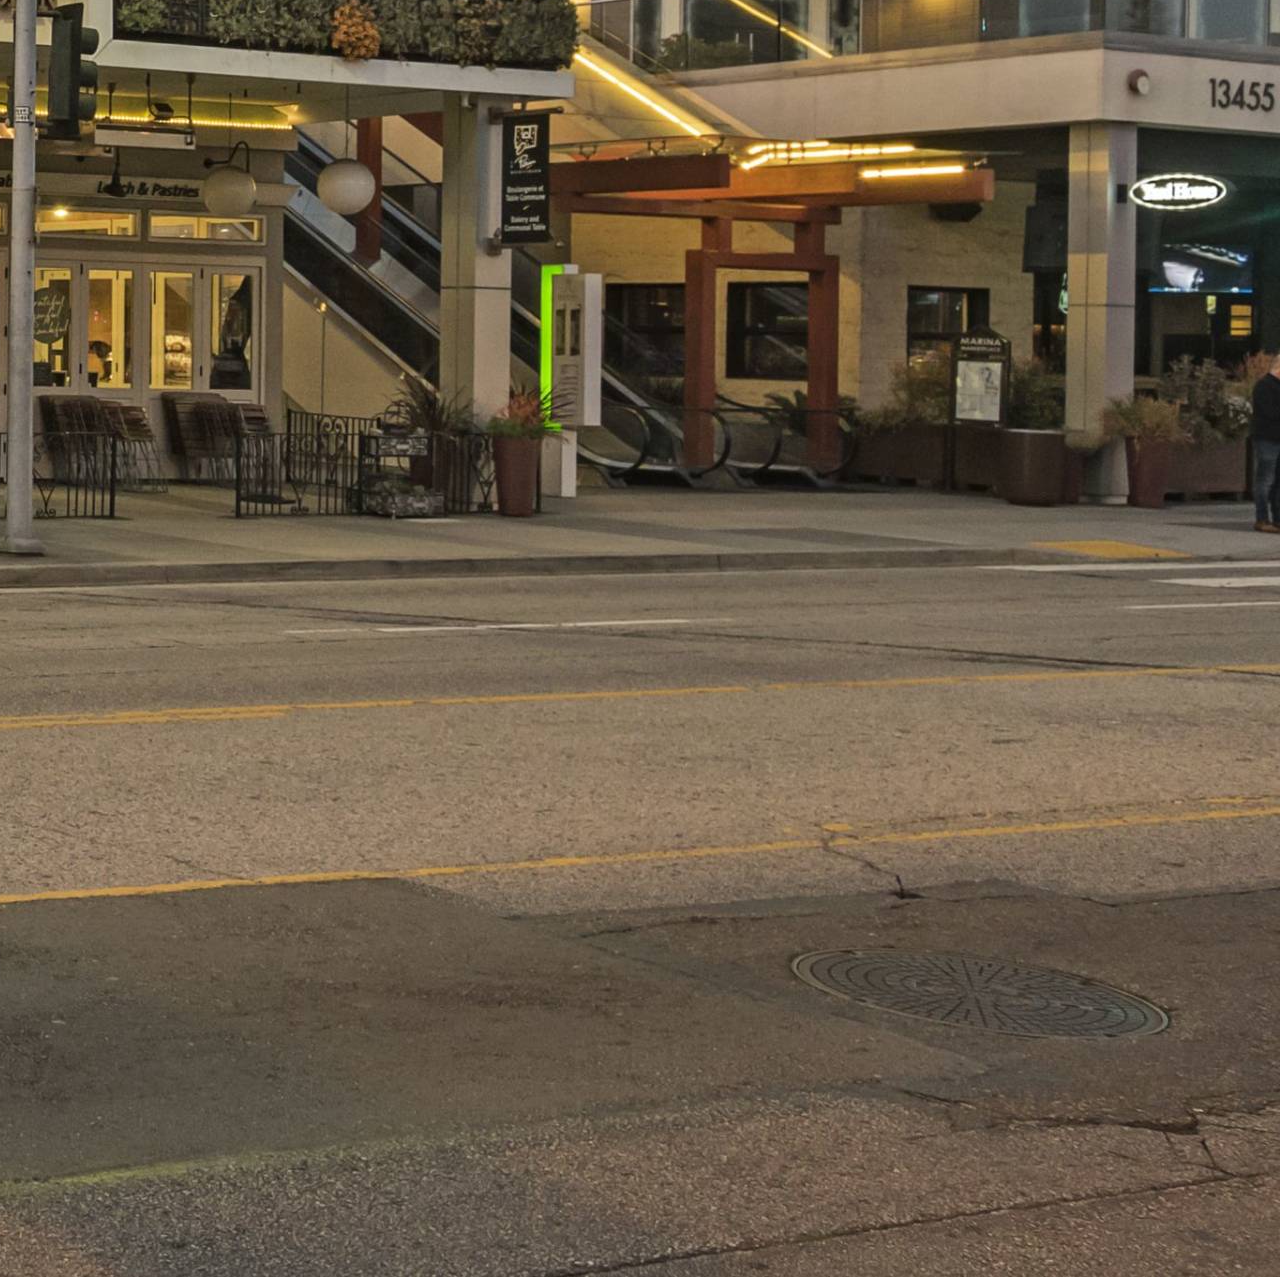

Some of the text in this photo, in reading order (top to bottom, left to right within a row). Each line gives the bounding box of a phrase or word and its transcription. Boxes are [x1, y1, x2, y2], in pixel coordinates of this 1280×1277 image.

[1209, 78, 1275, 112] 13455
[137, 181, 149, 195] &
[152, 183, 199, 197] Pastries
